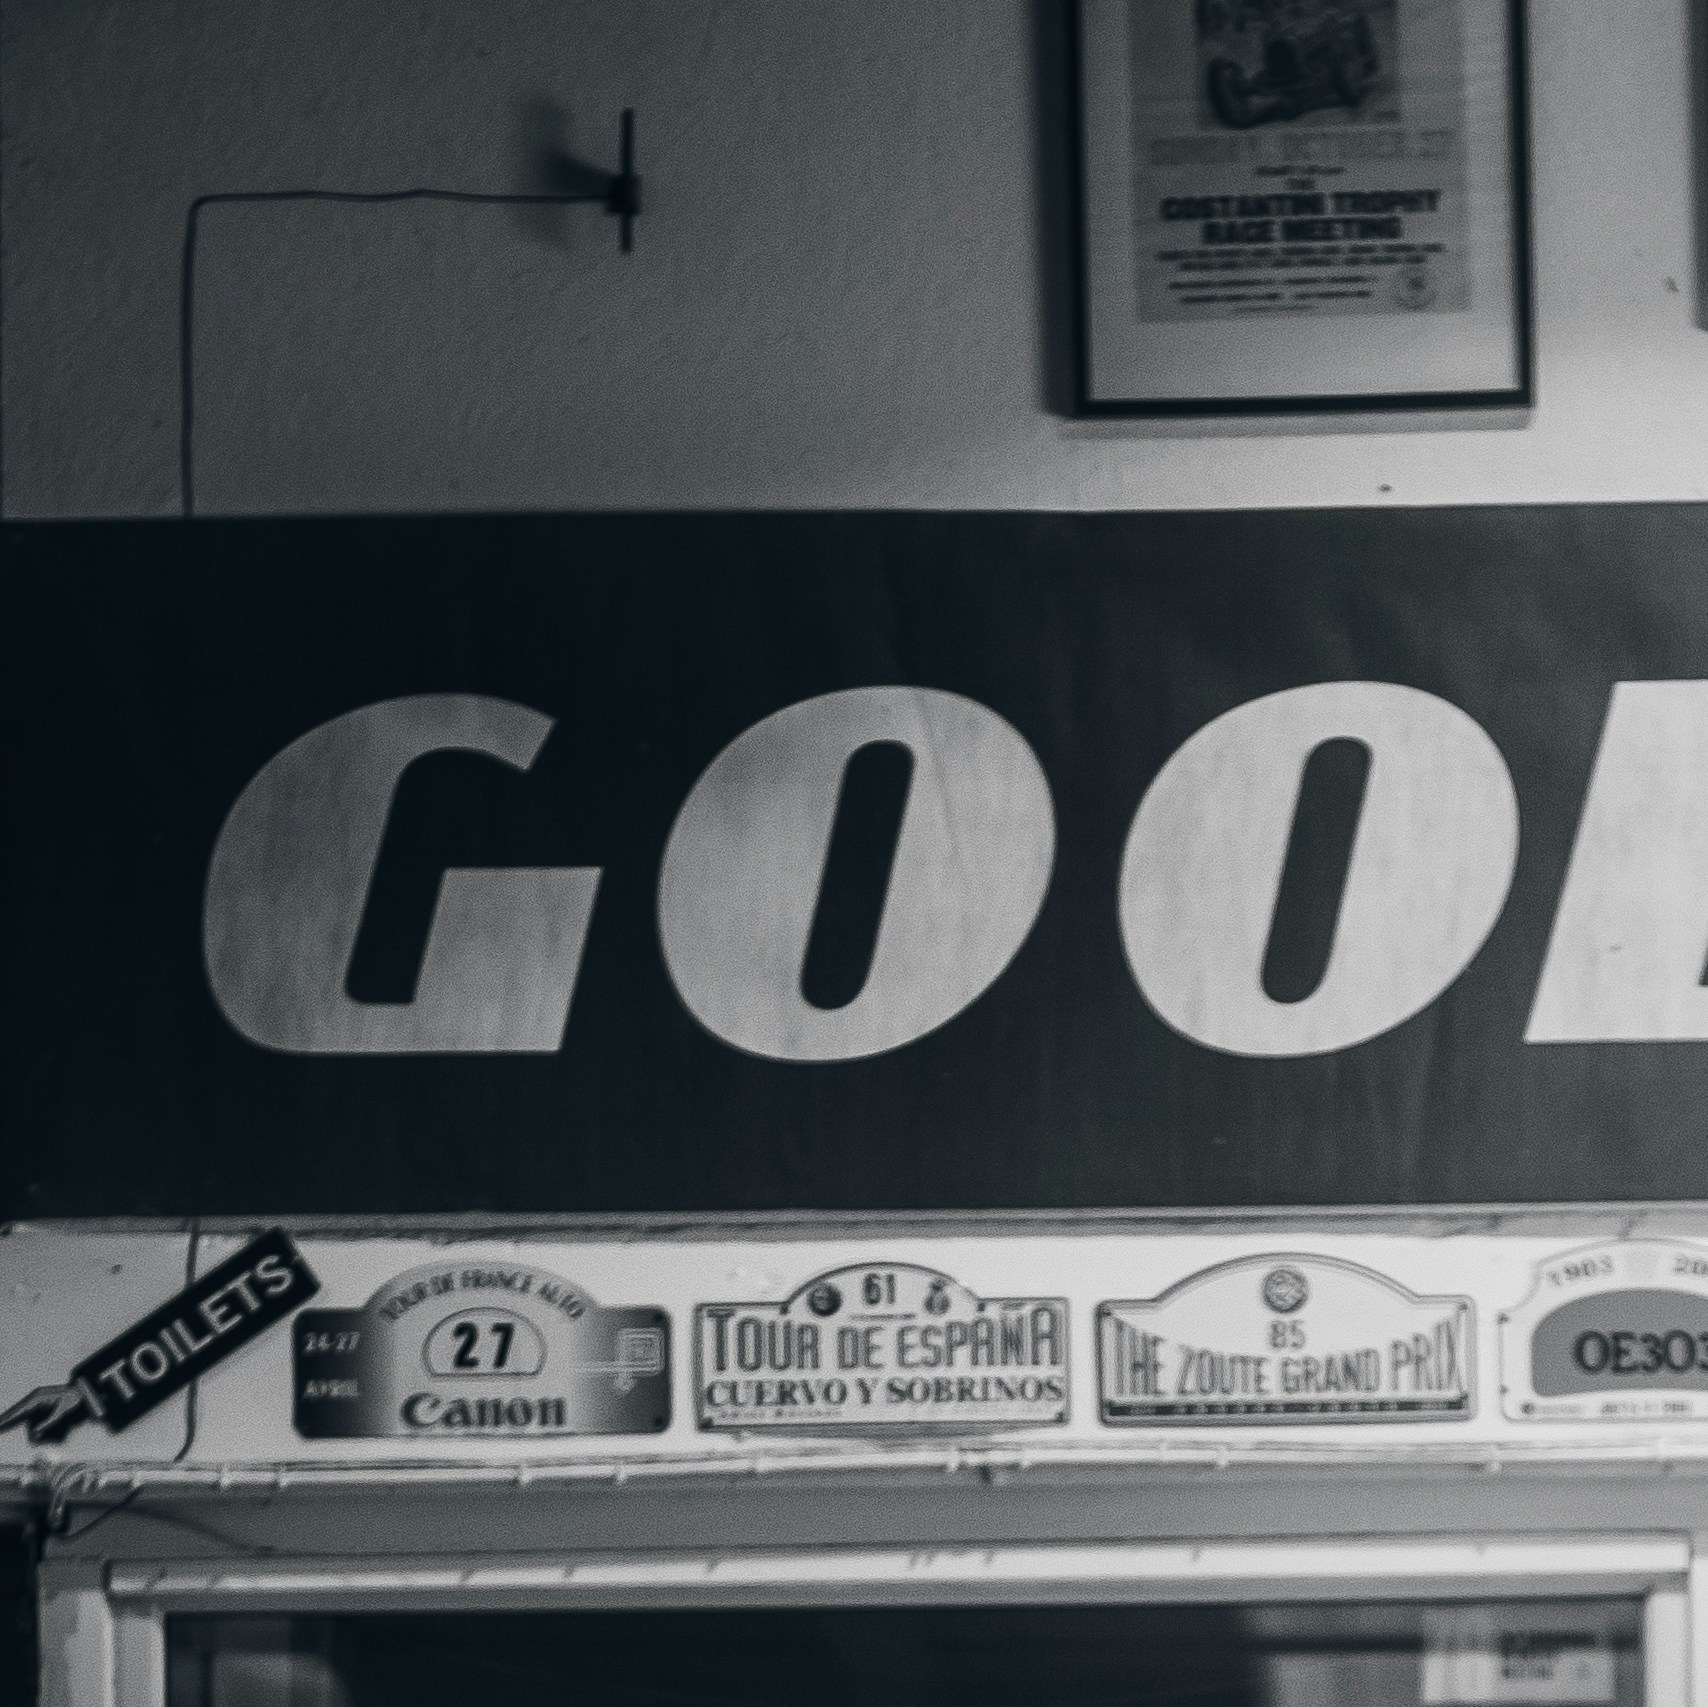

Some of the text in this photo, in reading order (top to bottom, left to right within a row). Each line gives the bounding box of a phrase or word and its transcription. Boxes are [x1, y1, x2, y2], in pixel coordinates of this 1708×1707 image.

[1333, 188, 1442, 215] TROPHY
[1203, 216, 1403, 243] RACE MEETING
[426, 1274, 457, 1300] DE
[459, 1268, 535, 1294] FRANCE
[535, 1279, 587, 1322] AUTO
[862, 1273, 897, 1304] 61
[98, 1252, 296, 1405] TOILETS
[452, 1322, 515, 1369] 27
[706, 1308, 821, 1371] TOUR
[837, 1325, 885, 1369] DE
[1106, 1312, 1465, 1395] THE ZOUTE GRAND PRIX
[401, 1392, 566, 1430] Canon
[706, 1375, 1064, 1408] CUERVO Y SOBRINOS
